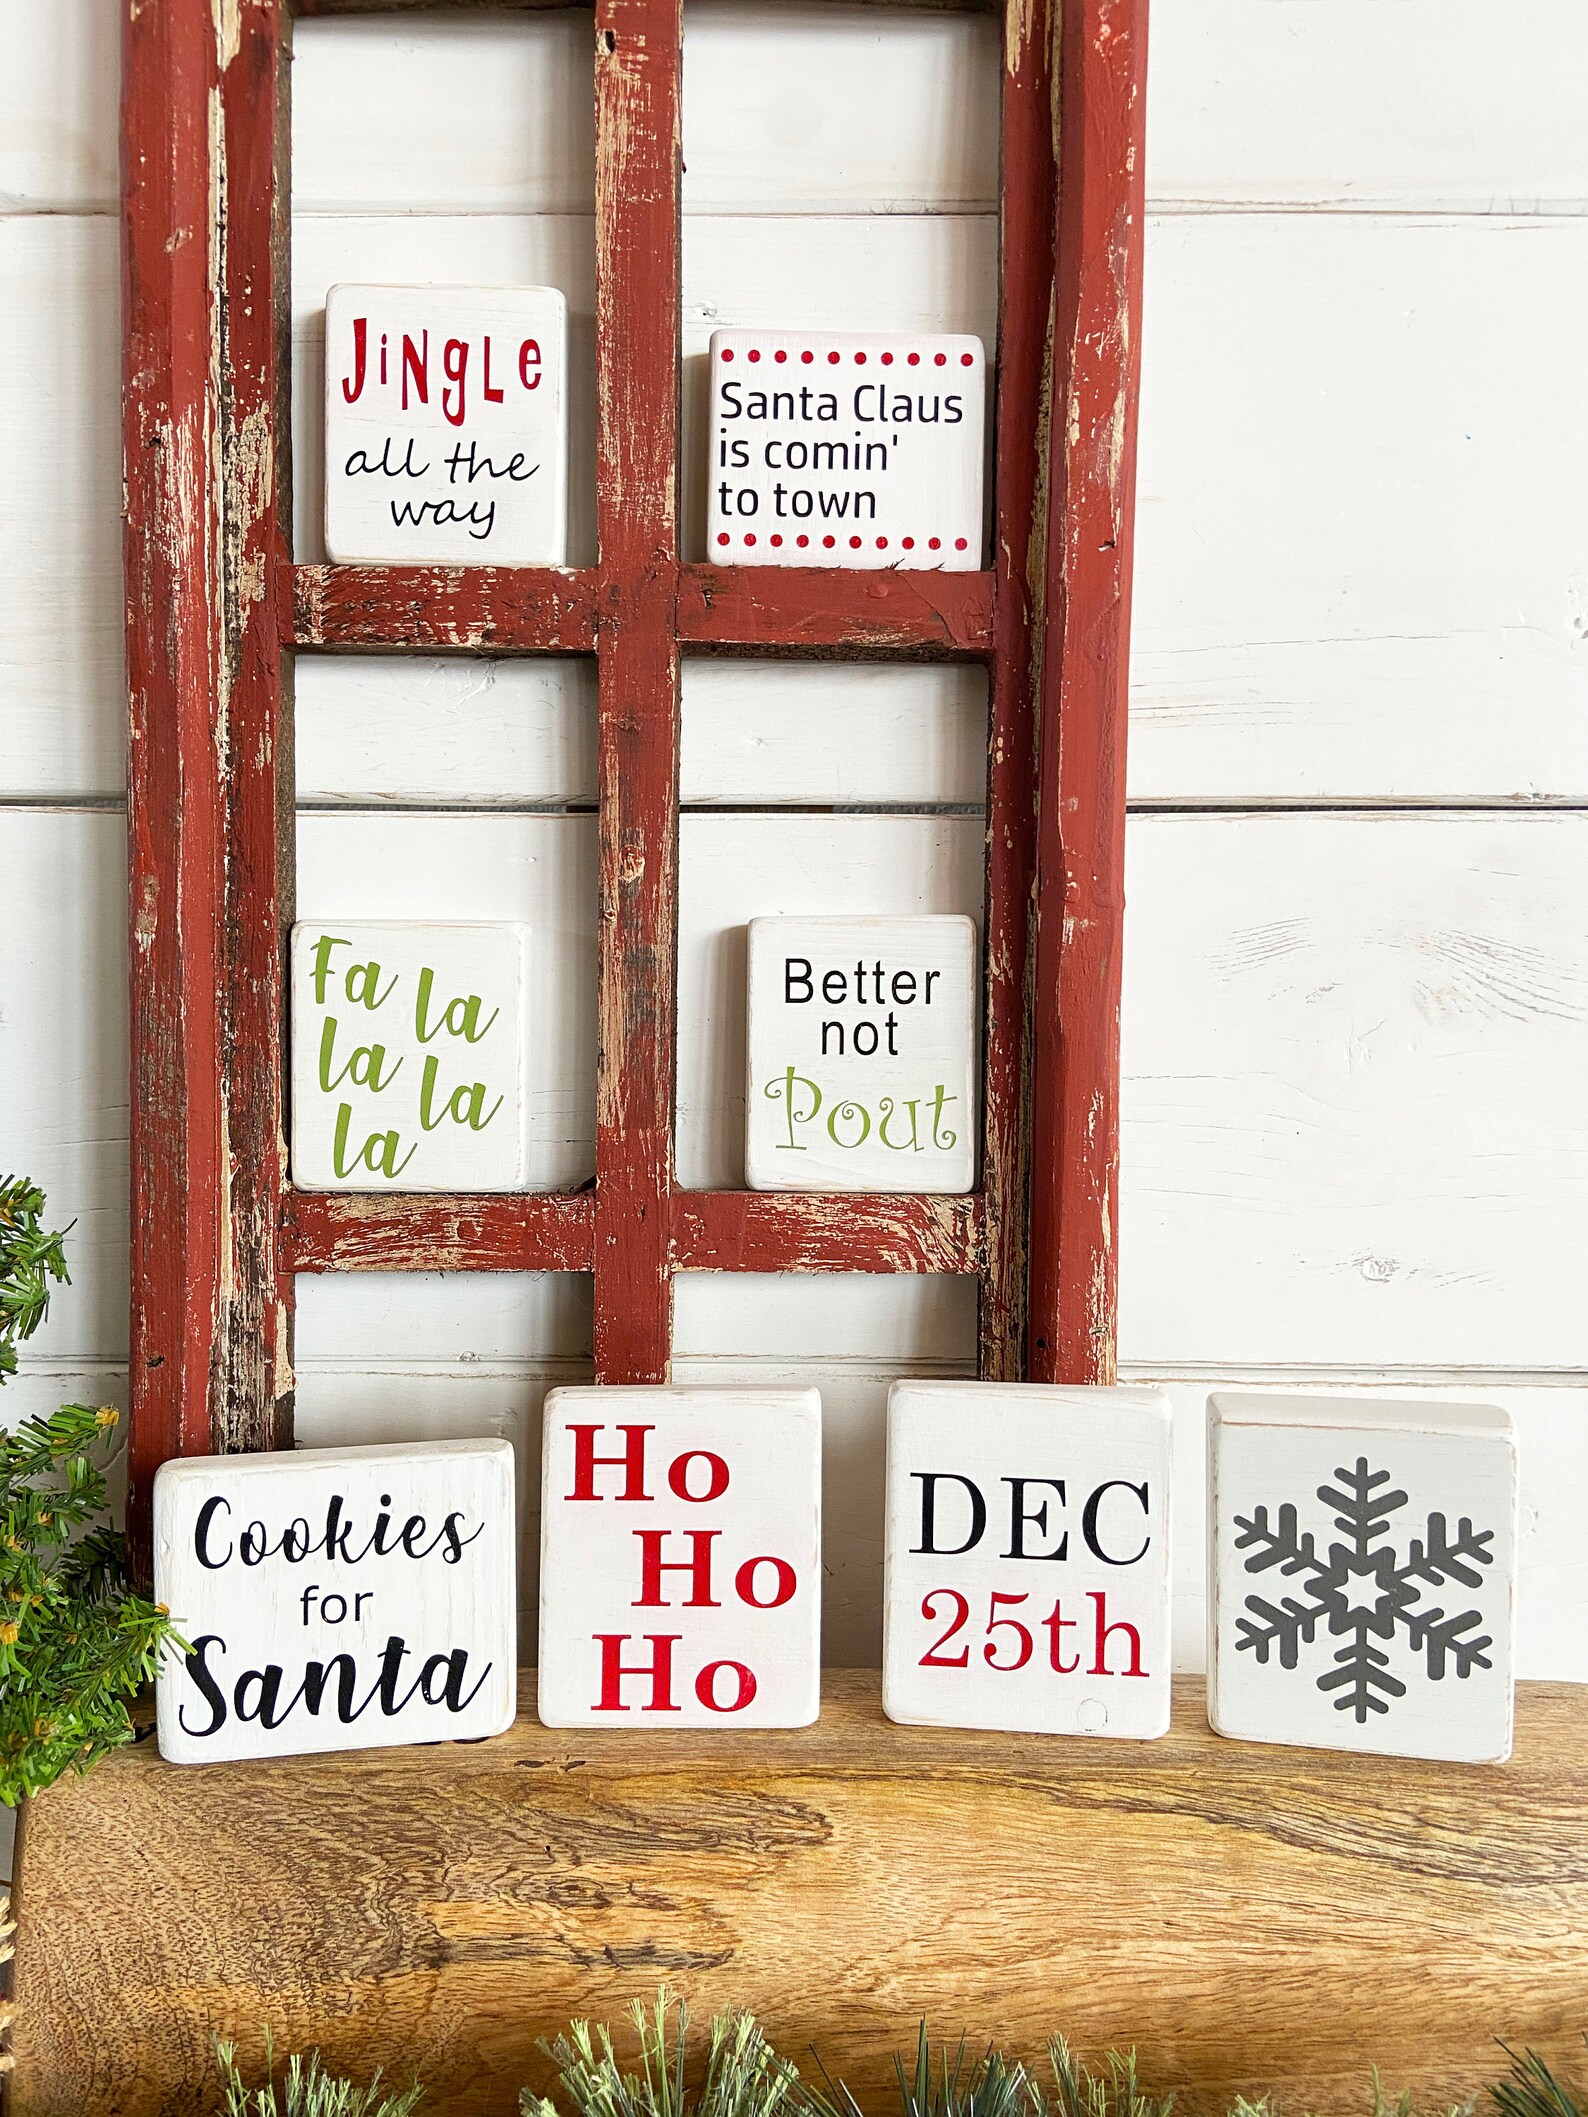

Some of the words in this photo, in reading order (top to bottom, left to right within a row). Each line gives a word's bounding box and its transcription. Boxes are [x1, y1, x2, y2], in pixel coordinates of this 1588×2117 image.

[721, 382, 837, 421] Santa
[854, 385, 962, 423] Claus
[345, 437, 430, 478] all
[444, 441, 540, 483] the
[721, 428, 749, 467] is
[765, 431, 897, 471] comin'
[391, 500, 495, 539] way
[719, 482, 758, 516] to
[774, 483, 875, 518] town
[310, 936, 398, 1010] Fa
[416, 968, 499, 1043] la
[785, 958, 940, 1004] Better
[822, 1012, 898, 1055] not
[319, 1017, 403, 1092] la
[420, 1055, 502, 1131] la
[764, 1067, 957, 1152] Pout
[334, 1103, 417, 1178] la
[564, 1425, 729, 1502] Ho
[195, 1494, 484, 1569] Cookies
[909, 1473, 1150, 1565] DEC
[300, 1585, 373, 1626] for
[631, 1530, 796, 1608] Ho
[918, 1589, 1149, 1677] 25th
[179, 1634, 493, 1738] Santa
[591, 1634, 757, 1712] Ho
